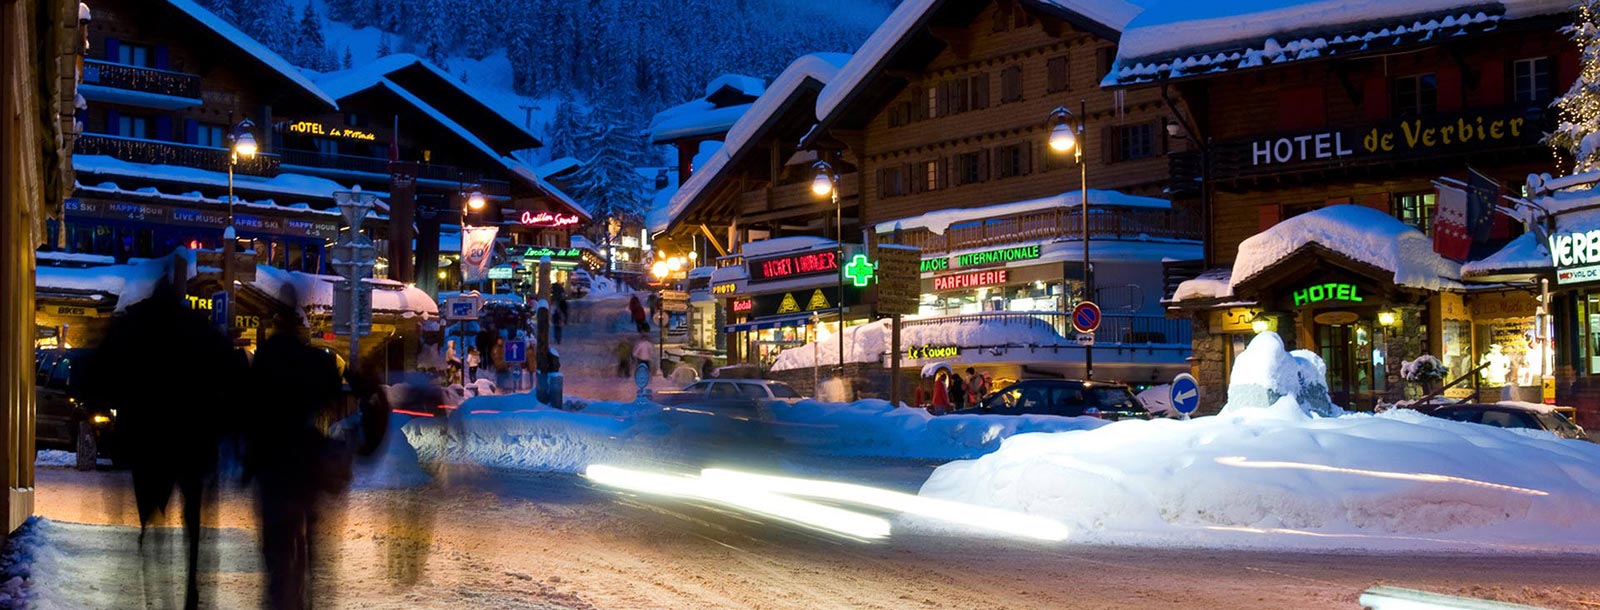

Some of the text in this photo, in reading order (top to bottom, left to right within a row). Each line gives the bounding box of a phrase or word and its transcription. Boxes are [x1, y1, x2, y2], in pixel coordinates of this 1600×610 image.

[290, 121, 325, 135] HOTEL
[1252, 116, 1524, 166] HOTEL de Verbier
[80, 203, 96, 212] SKI
[109, 201, 164, 216] HAPPY HOUR
[173, 212, 223, 225] LIVE MUSIC
[264, 220, 279, 230] SKI
[289, 220, 336, 231] HAPPY HOUR
[470, 248, 484, 258] 20
[957, 244, 1041, 267] INTERNATIONALE
[934, 270, 1007, 290] PARFUMERIE
[712, 283, 736, 295] PHOTO
[1293, 283, 1363, 306] HOTEL
[58, 307, 85, 315] BIKES
[907, 346, 918, 360] Le
